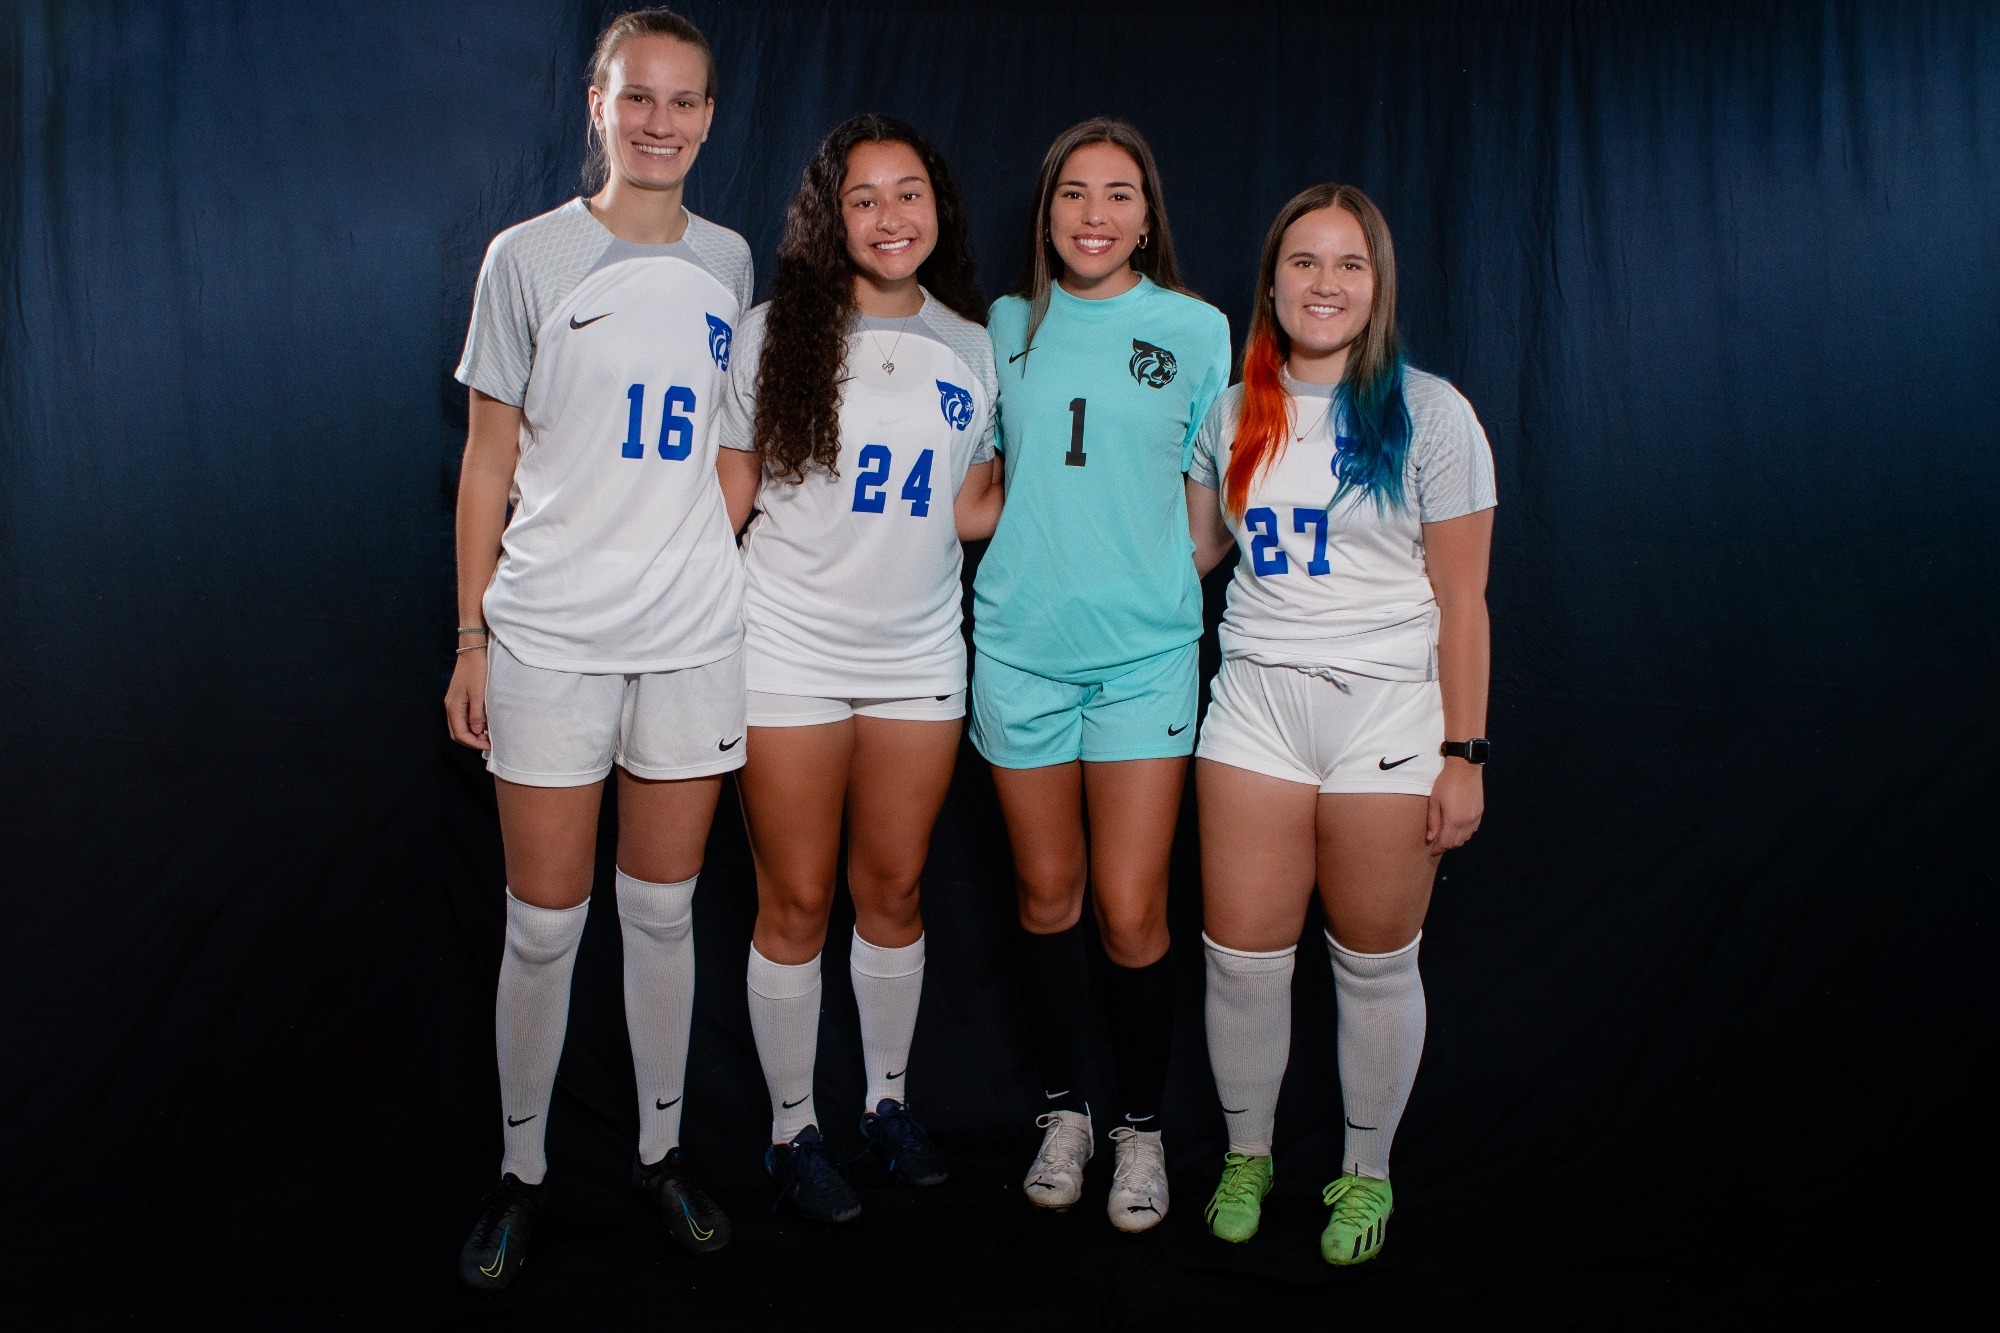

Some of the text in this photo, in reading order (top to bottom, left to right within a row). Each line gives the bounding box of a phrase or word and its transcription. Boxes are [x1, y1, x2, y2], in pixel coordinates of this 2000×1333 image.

[621, 383, 697, 461] 16
[1064, 397, 1088, 467] 1
[851, 443, 934, 518] 24
[1244, 506, 1332, 577] 27
